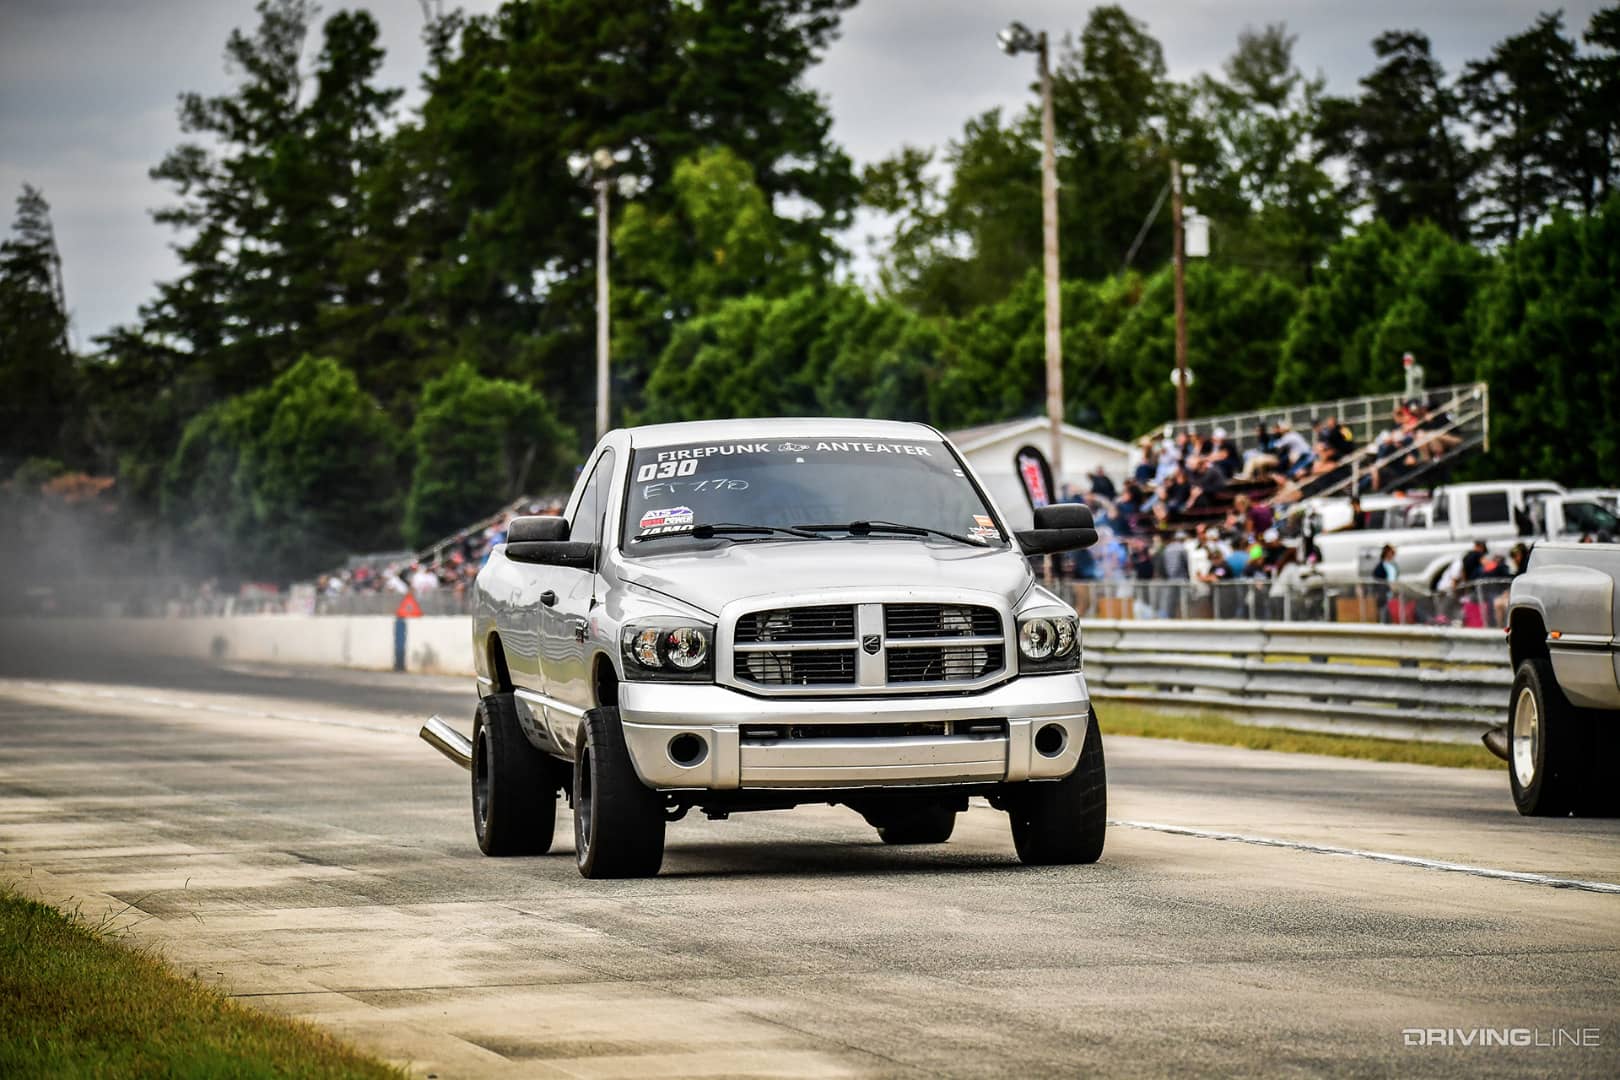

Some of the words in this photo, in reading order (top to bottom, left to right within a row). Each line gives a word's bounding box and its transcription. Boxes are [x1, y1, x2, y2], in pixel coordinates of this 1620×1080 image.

[657, 443, 771, 463] FIREPUNK
[815, 442, 933, 457] ANTEATER
[636, 459, 699, 482] 030
